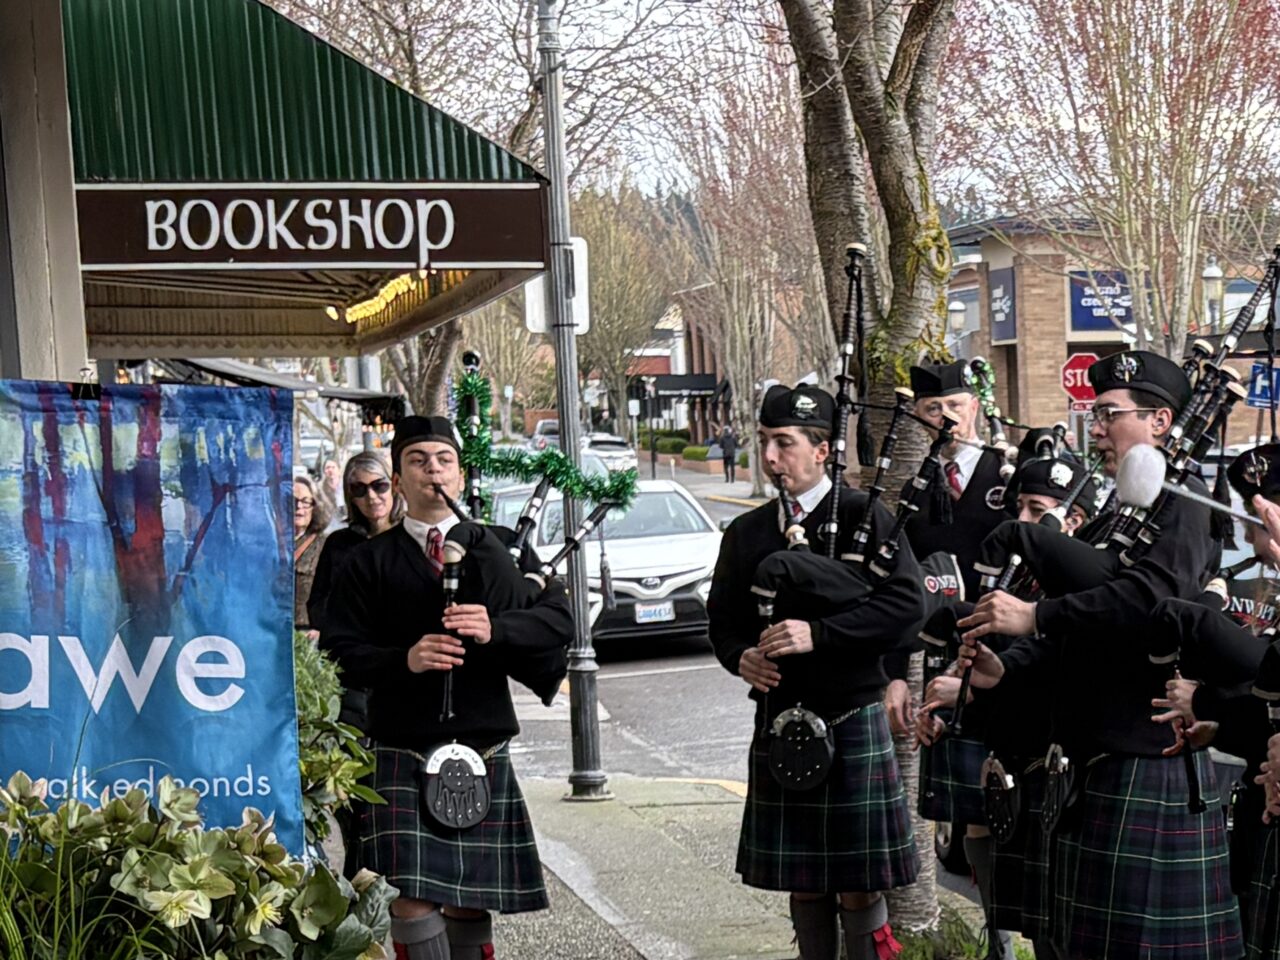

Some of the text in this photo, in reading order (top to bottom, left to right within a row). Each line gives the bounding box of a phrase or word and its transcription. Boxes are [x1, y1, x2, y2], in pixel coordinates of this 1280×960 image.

[145, 199, 454, 268] BOOKSHOP
[1064, 368, 1092, 387] STO
[0, 632, 246, 715] awe
[47, 764, 272, 798] alk edonds
